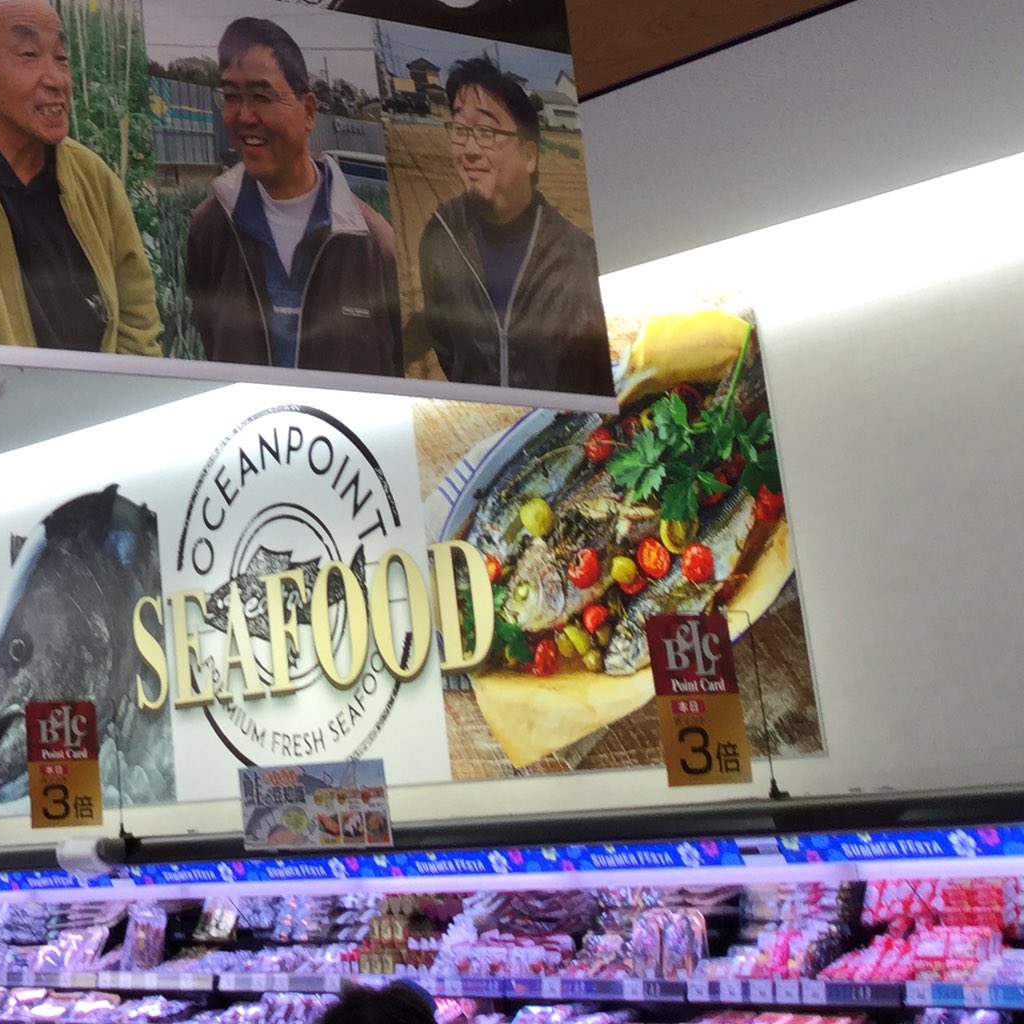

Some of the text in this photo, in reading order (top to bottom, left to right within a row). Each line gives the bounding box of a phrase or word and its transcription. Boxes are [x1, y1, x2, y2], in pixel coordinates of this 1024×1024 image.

[191, 425, 388, 576] OCEANPOINT
[132, 539, 495, 711] SEAFOOD
[270, 728, 326, 758] FRESH
[677, 725, 742, 776] 3倍
[41, 783, 95, 821] 3倍
[590, 849, 674, 868] SUMMER FESTA
[841, 839, 943, 858] SUMMER FESTA
